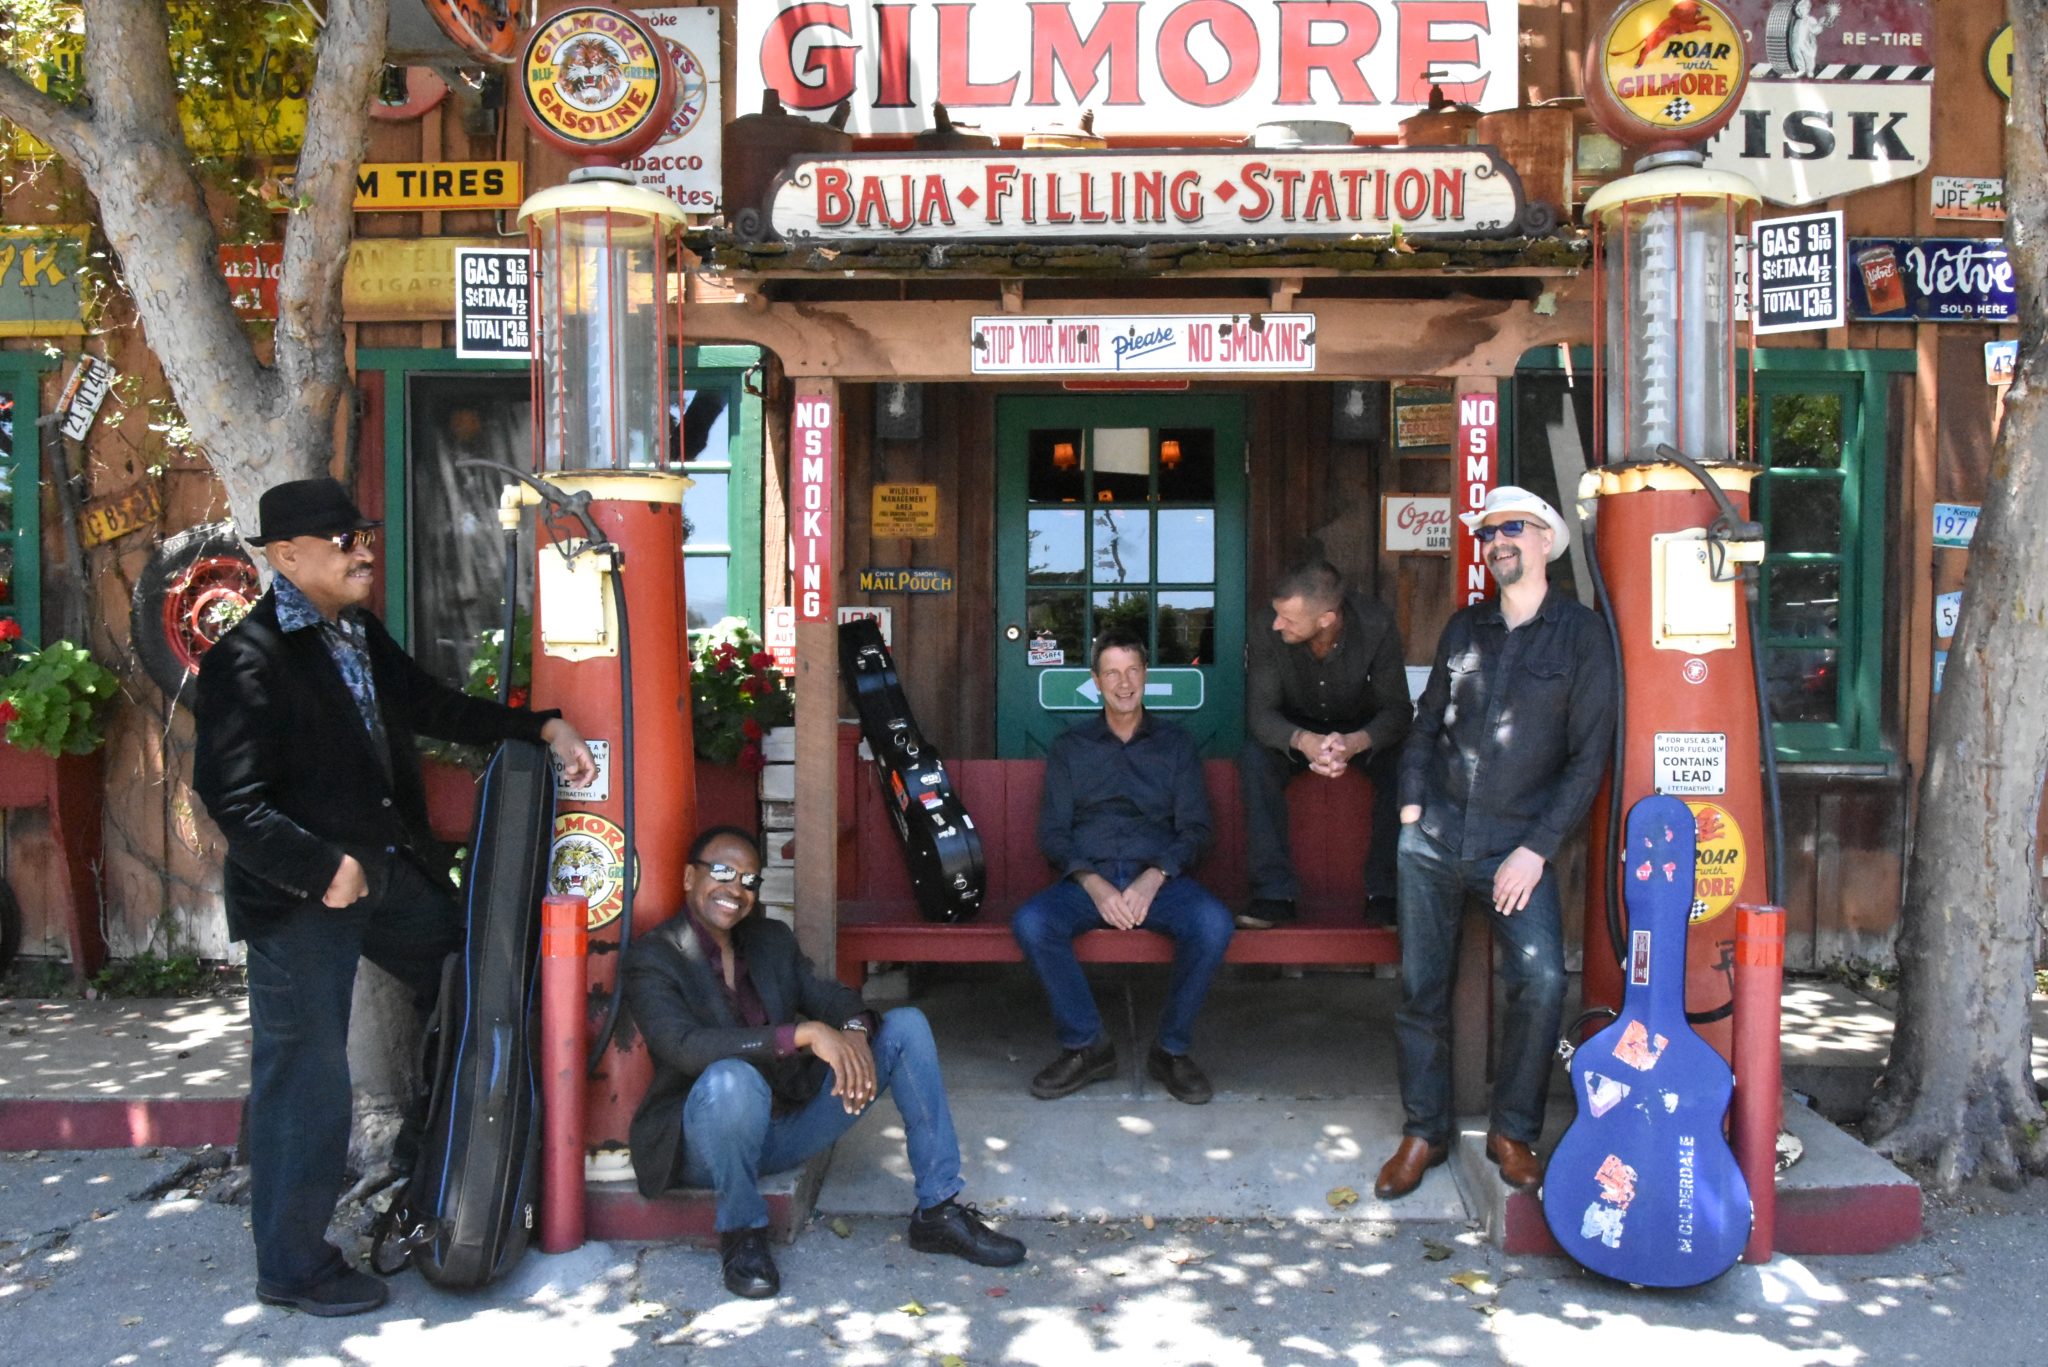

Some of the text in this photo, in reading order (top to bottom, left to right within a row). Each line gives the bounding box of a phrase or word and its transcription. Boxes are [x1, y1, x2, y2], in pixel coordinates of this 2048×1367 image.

[535, 14, 648, 63] GILMORE
[1842, 32, 1922, 46] RE-TIRE
[758, 0, 1492, 110] GILMORE
[1663, 41, 1731, 60] ROAR
[624, 67, 657, 79] GREEN
[1677, 58, 1718, 71] with
[1618, 73, 1728, 99] GILMORE
[539, 87, 648, 134] GASOLINE
[397, 168, 504, 197] TIRES
[641, 173, 666, 184] and
[660, 185, 714, 206] ttes
[815, 162, 1466, 233] BAJA FILLING STATION
[1936, 189, 2007, 212] JPE 74
[1762, 226, 1800, 257] GAS
[465, 257, 500, 285] GAS
[1763, 290, 1802, 314] TOTAL
[1940, 303, 2008, 314] SOLD HERE
[466, 320, 501, 339] TOTAL
[982, 325, 1014, 364] STOP
[1019, 325, 1055, 364] YOUR
[1058, 324, 1100, 364] MOTOR
[1188, 323, 1212, 362] NO
[1219, 322, 1306, 362] SMOKING
[796, 402, 830, 429] NO
[1461, 400, 1495, 426] NO
[881, 495, 928, 503] MANAGEMENT
[889, 487, 919, 495] WILDLIFE
[801, 430, 824, 618] SMOKING
[1466, 427, 1489, 606] SMOING
[860, 571, 952, 591] MAIL POUCH
[1663, 757, 1719, 766] CONTAINS
[1672, 770, 1712, 783] LEAD
[1697, 865, 1728, 875] with
[1696, 877, 1735, 897] ORE
